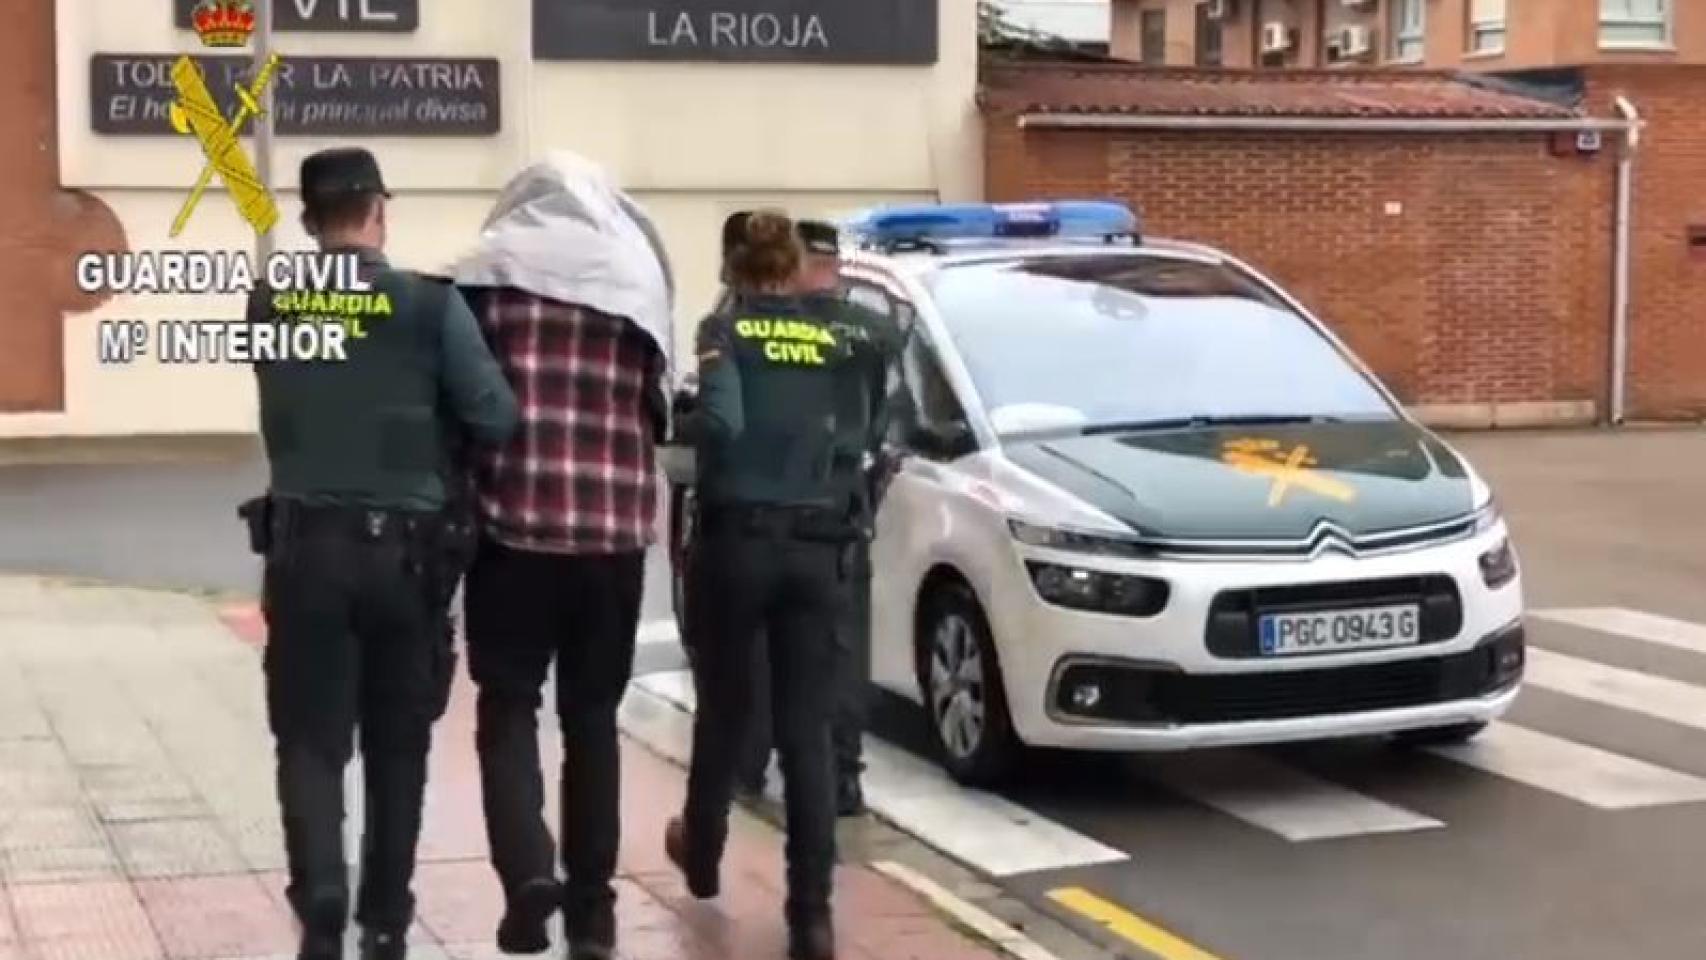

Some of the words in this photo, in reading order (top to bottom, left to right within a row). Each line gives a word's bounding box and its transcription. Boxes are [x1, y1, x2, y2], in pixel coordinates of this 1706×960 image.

[648, 11, 698, 46] LA
[711, 12, 829, 48] RIOJA
[313, 63, 351, 88] LA
[370, 63, 484, 88] PATRIA
[764, 340, 826, 365] CIVIL
[1278, 617, 1328, 648] PGC
[1332, 611, 1394, 644] 0943
[1398, 609, 1415, 638] G
